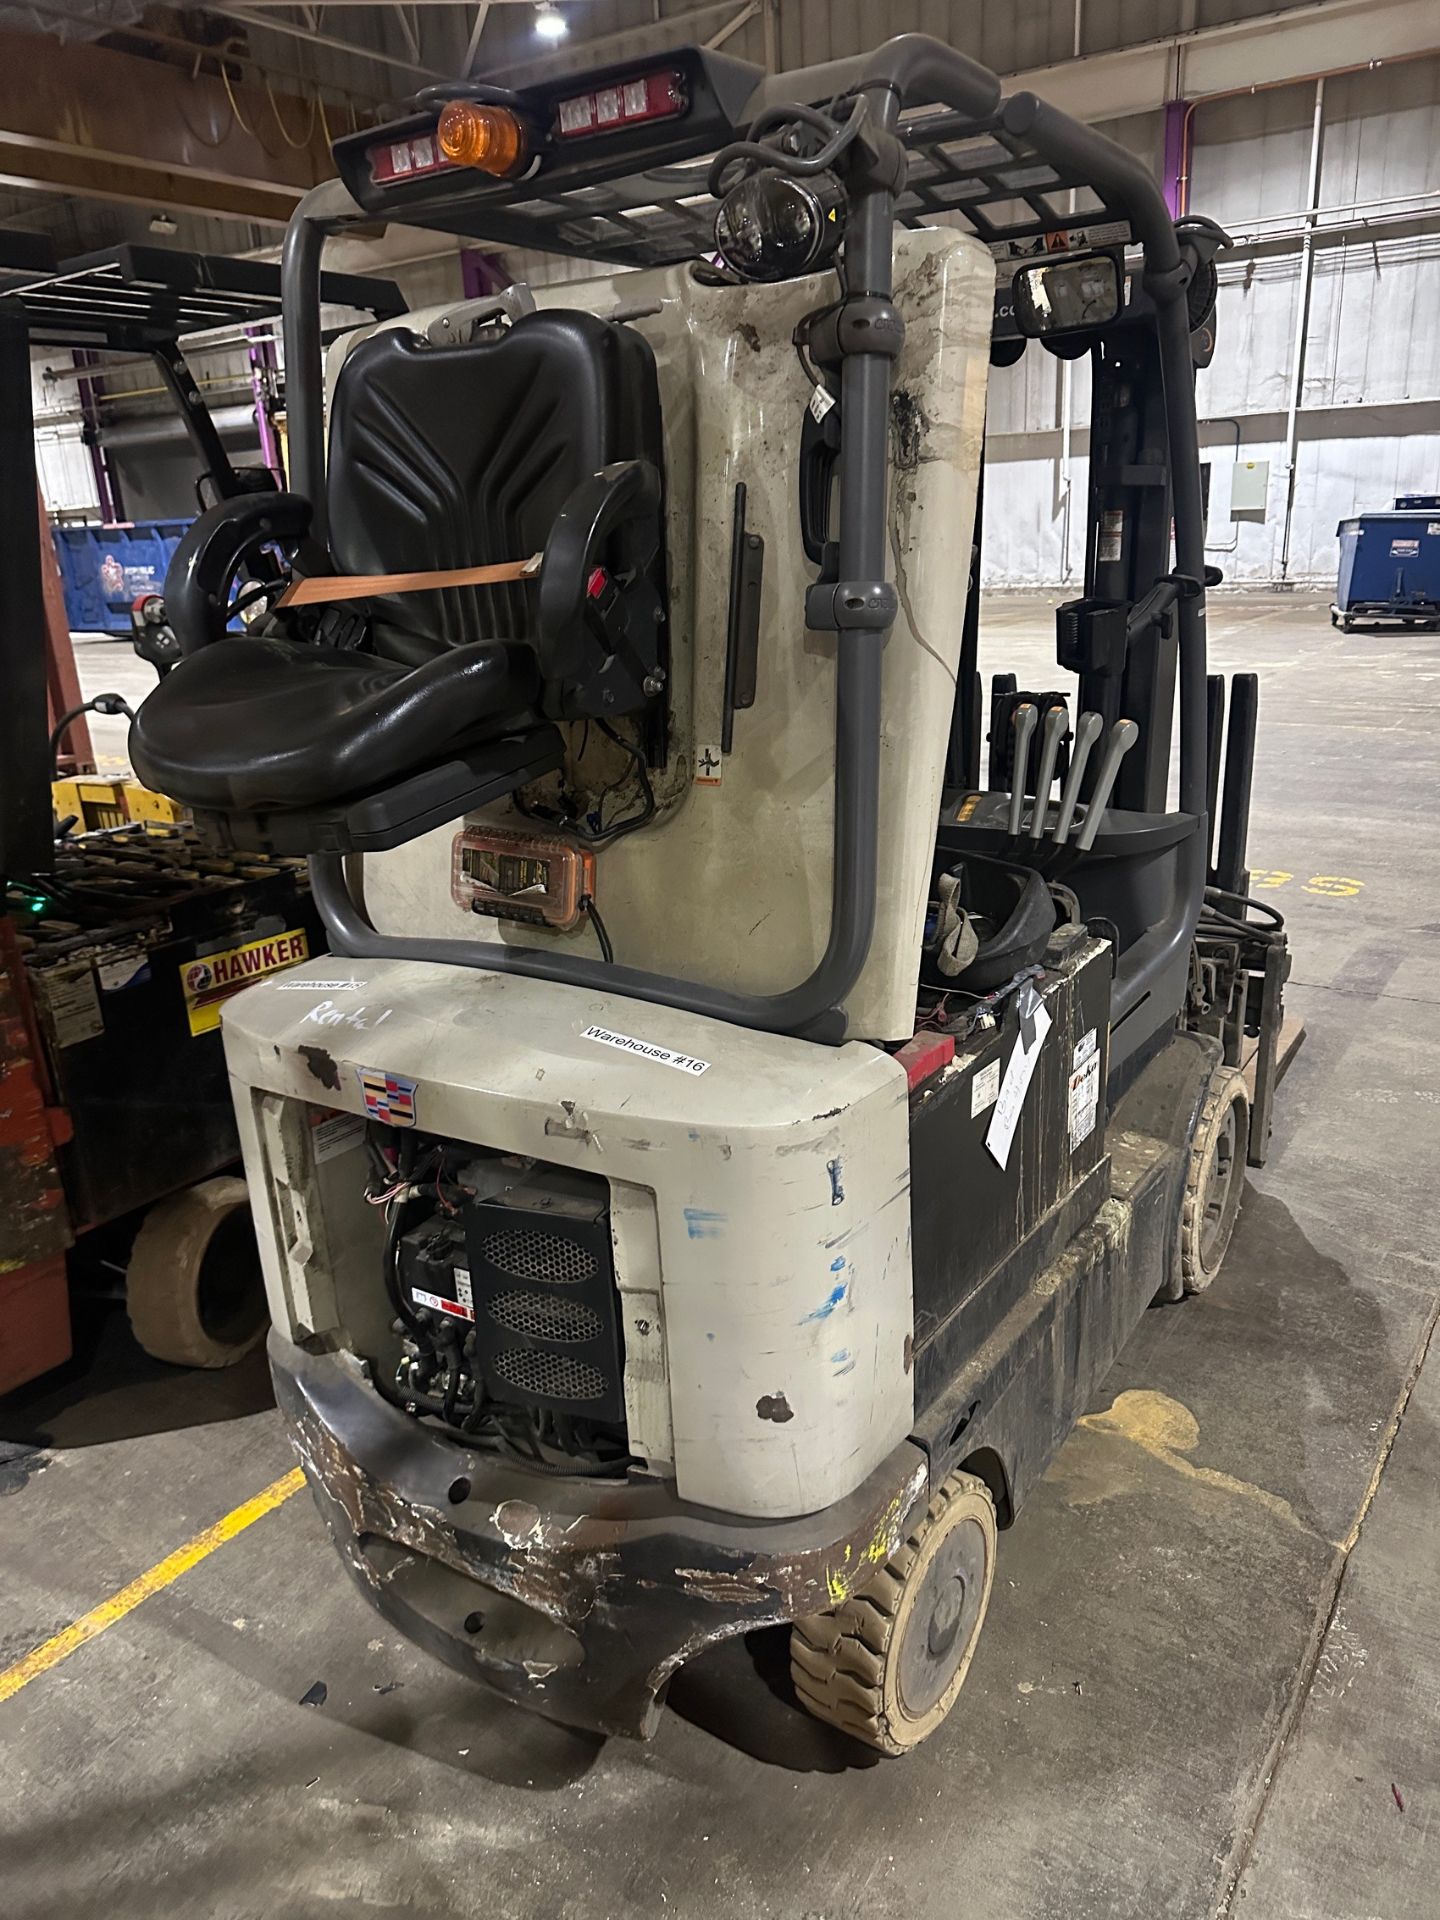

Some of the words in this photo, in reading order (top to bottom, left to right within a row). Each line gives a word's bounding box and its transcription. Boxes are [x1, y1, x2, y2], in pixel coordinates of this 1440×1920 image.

[212, 933, 305, 984] HAWKER
[587, 1027, 671, 1060] Warehouse
[672, 1055, 706, 1072] #16
